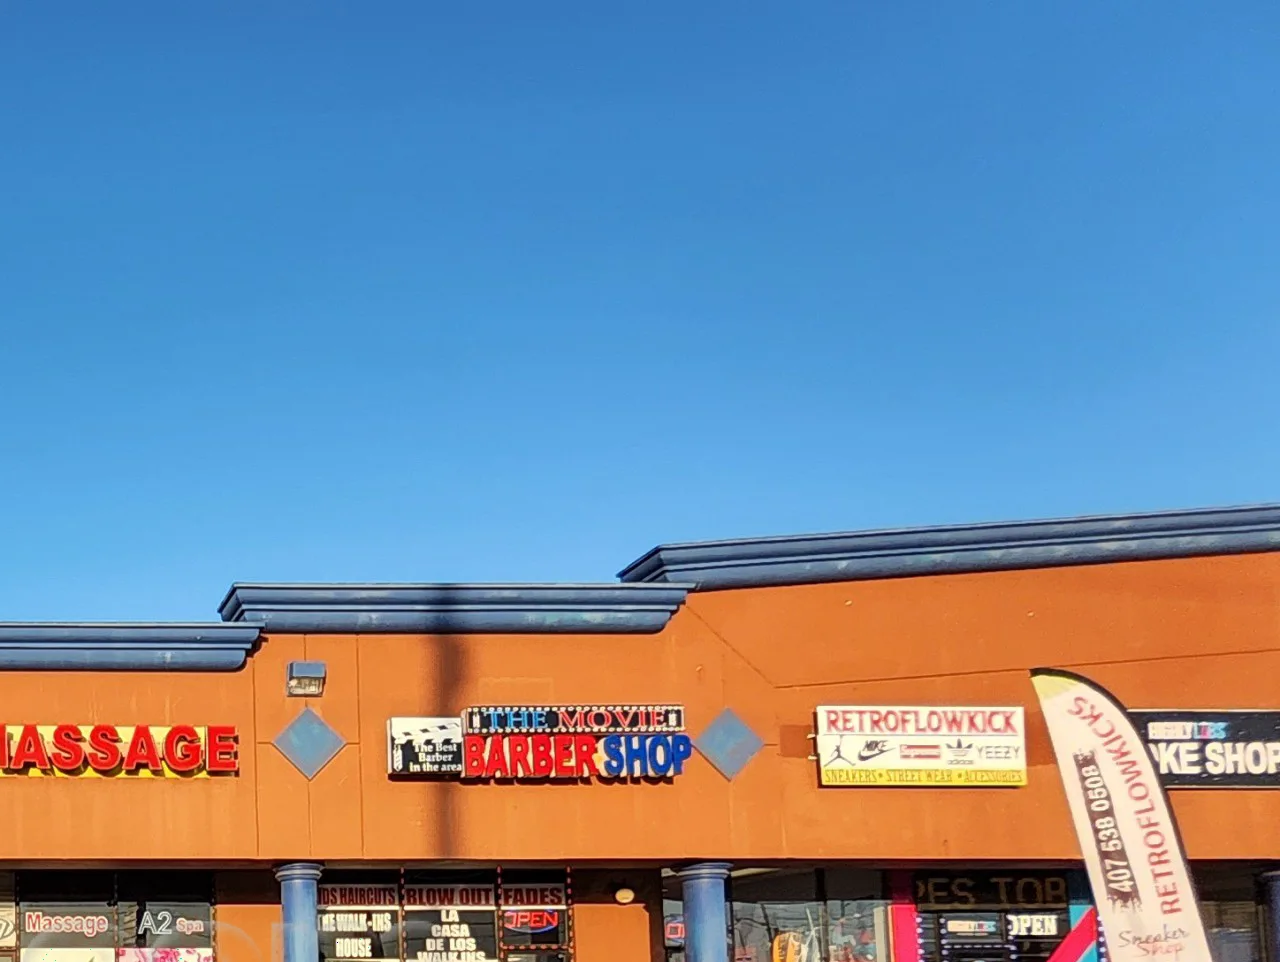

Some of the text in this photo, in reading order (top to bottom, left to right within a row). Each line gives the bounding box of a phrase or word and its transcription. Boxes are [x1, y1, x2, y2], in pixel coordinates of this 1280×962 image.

[483, 709, 667, 730] THE MOVIE
[824, 709, 1019, 733] RETROFLOWKICK
[414, 742, 458, 752] The Best
[463, 734, 693, 778] BARBER SHOP
[418, 752, 453, 762] Barber
[422, 762, 439, 772] the
[440, 763, 462, 772] area
[1082, 763, 1134, 894] 407 538 0508
[340, 887, 396, 905] HAIRCUTS
[404, 887, 492, 906] BLOW OUT
[502, 887, 562, 905] FADES
[25, 912, 109, 937] Massage
[138, 911, 205, 935] A2 Spa
[440, 909, 460, 922] LA
[431, 924, 470, 938] CASA
[335, 938, 372, 958] HOUSE
[425, 937, 477, 951] DE LOS
